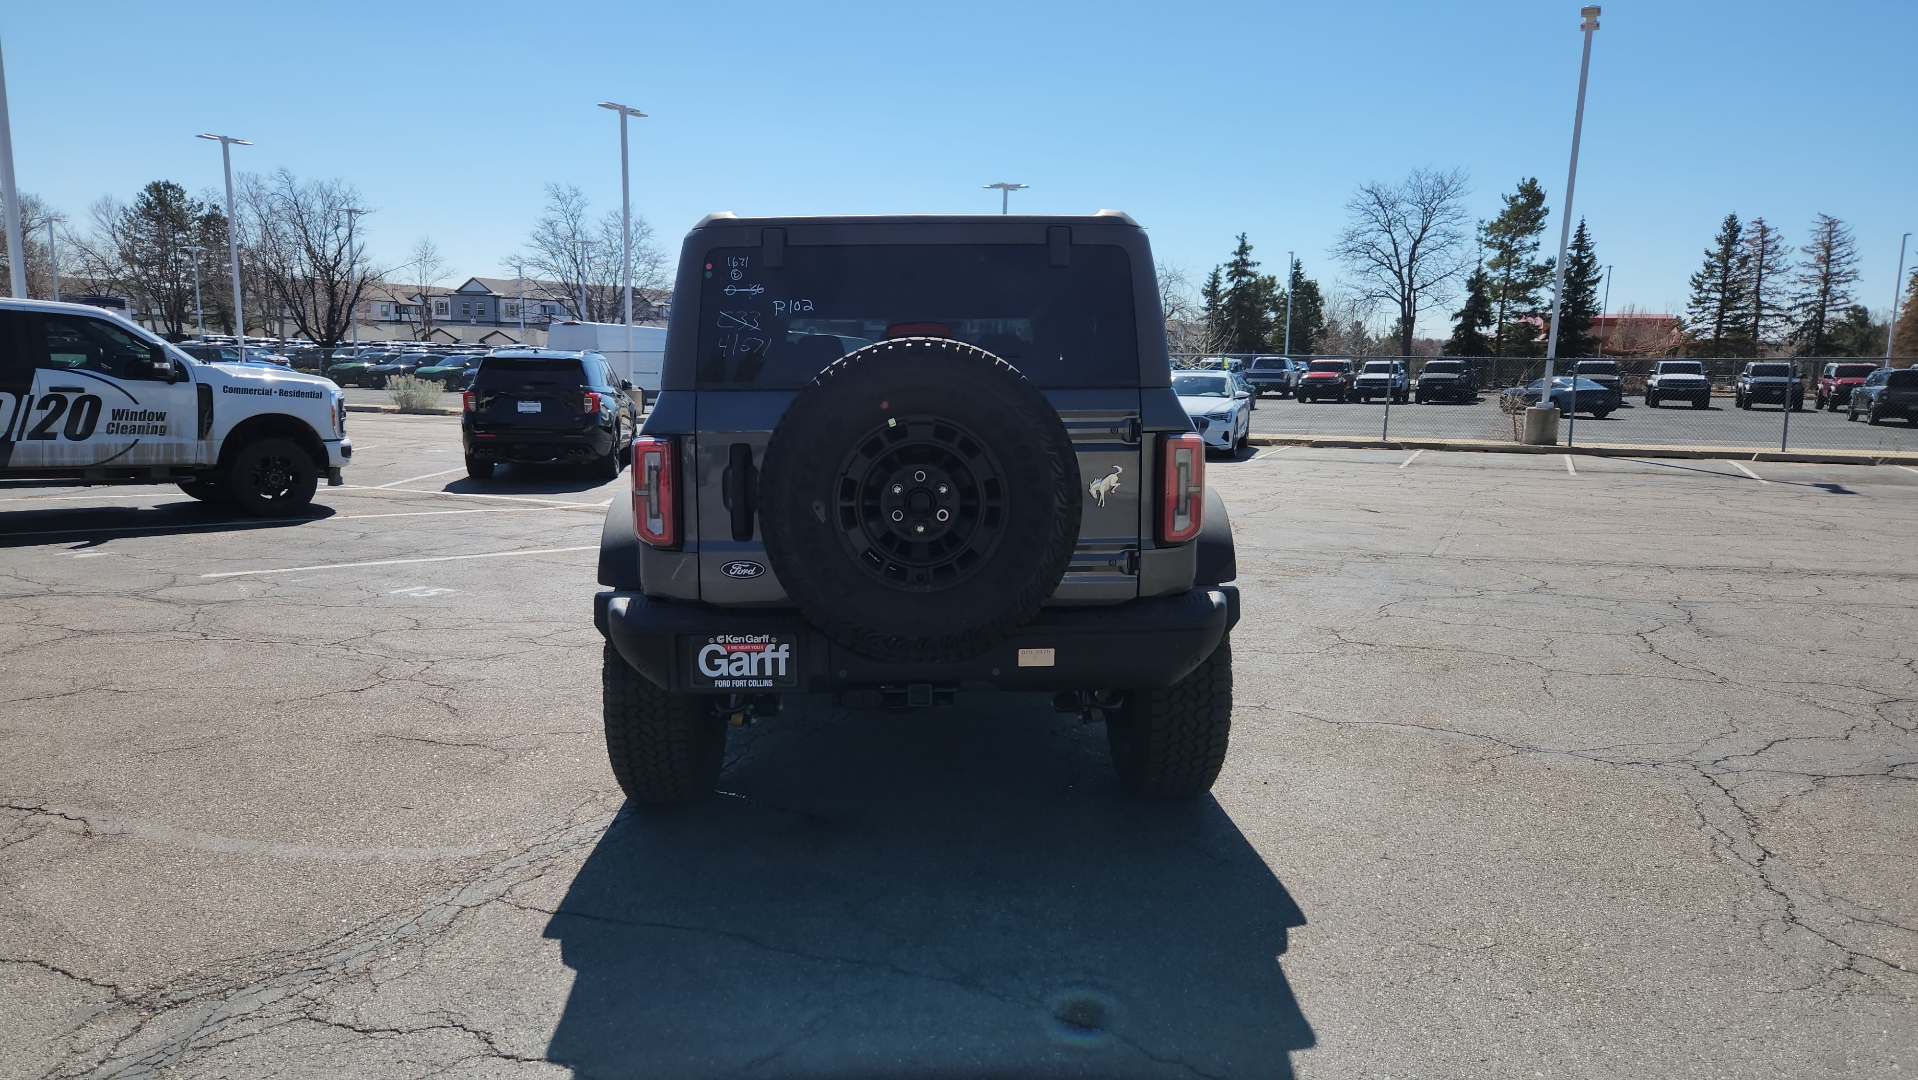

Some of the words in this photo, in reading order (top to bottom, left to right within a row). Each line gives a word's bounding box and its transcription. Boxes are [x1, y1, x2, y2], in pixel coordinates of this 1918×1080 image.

[727, 256, 749, 268] 1671
[222, 385, 273, 396] Commercial
[278, 388, 323, 400] Residential
[111, 408, 167, 422] Window
[105, 422, 168, 437] Cleaning
[729, 563, 757, 576] Ford
[725, 634, 745, 643] Ken
[745, 634, 770, 643] Garff
[698, 643, 790, 678] Garff
[714, 679, 731, 688] FORD
[731, 679, 747, 688] FORT
[748, 679, 773, 687] COLLINS
